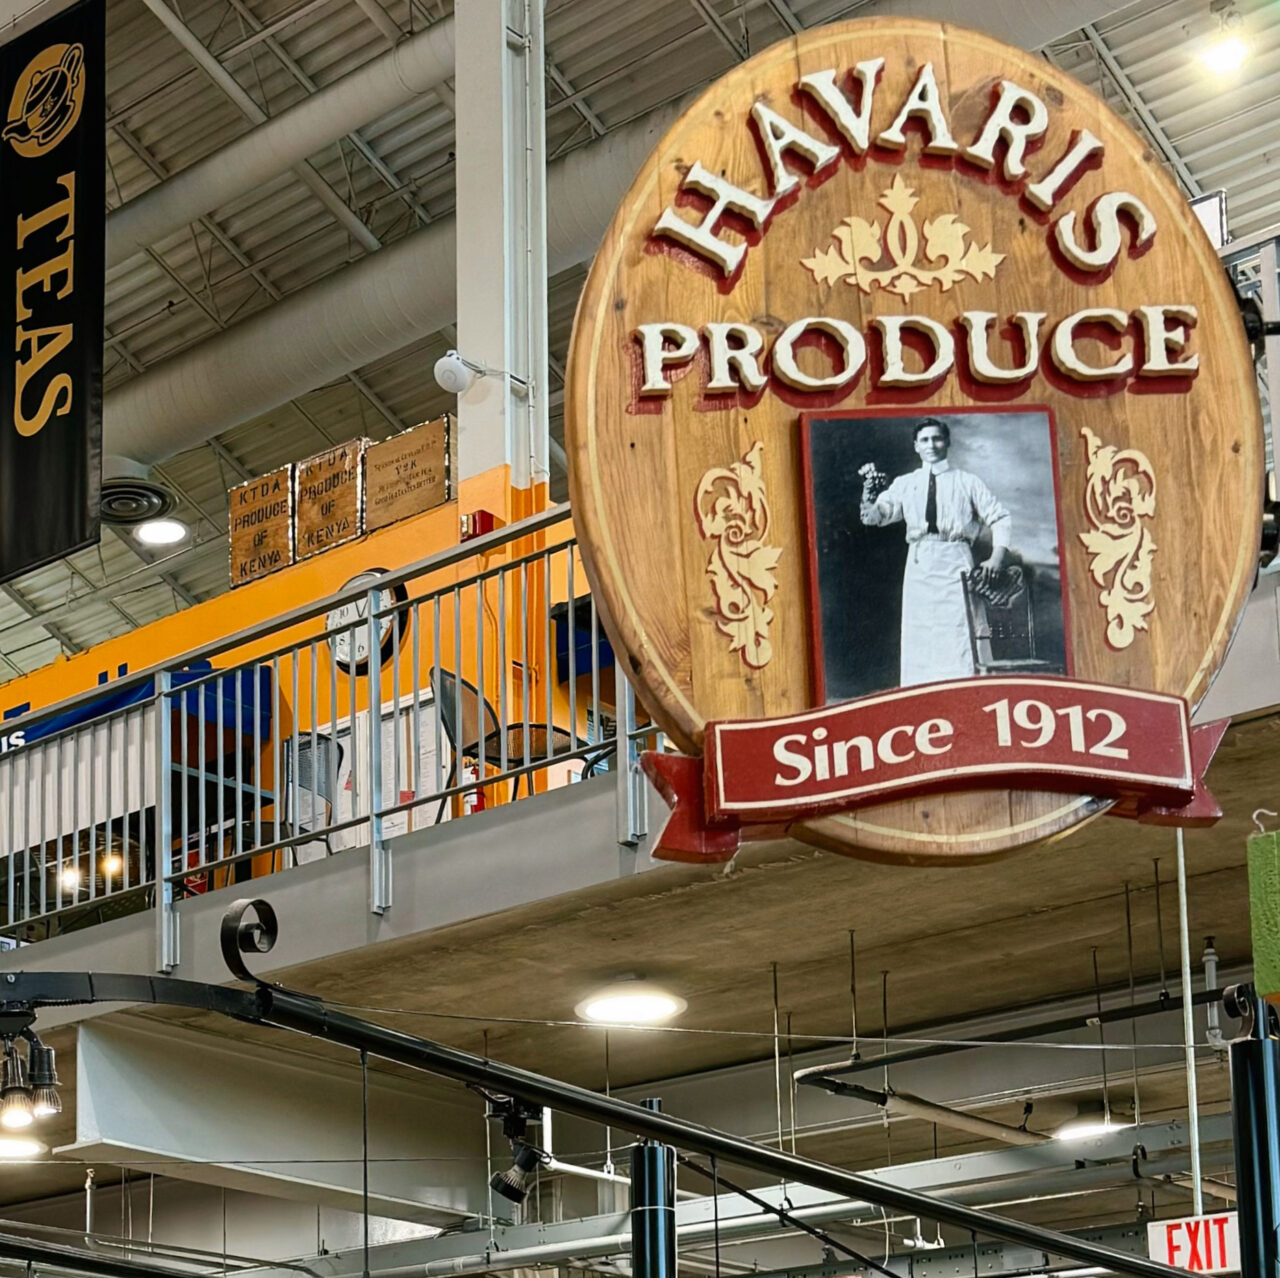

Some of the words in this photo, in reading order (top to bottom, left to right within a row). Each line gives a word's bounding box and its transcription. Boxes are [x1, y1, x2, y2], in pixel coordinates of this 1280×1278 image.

[652, 56, 1157, 279] HAVARIS
[14, 171, 76, 437] TEAS
[634, 304, 1201, 397] PRODUCE
[239, 478, 281, 505] KTDA
[299, 466, 356, 500] PRODUCE
[234, 500, 287, 532] PRODUCE
[321, 500, 336, 516] OF
[253, 532, 268, 548] OF
[306, 517, 350, 548] KENYA
[239, 549, 282, 578] KENYA
[773, 717, 955, 787] Since
[982, 699, 1131, 760] 1912
[1165, 1217, 1229, 1271] EXIT
